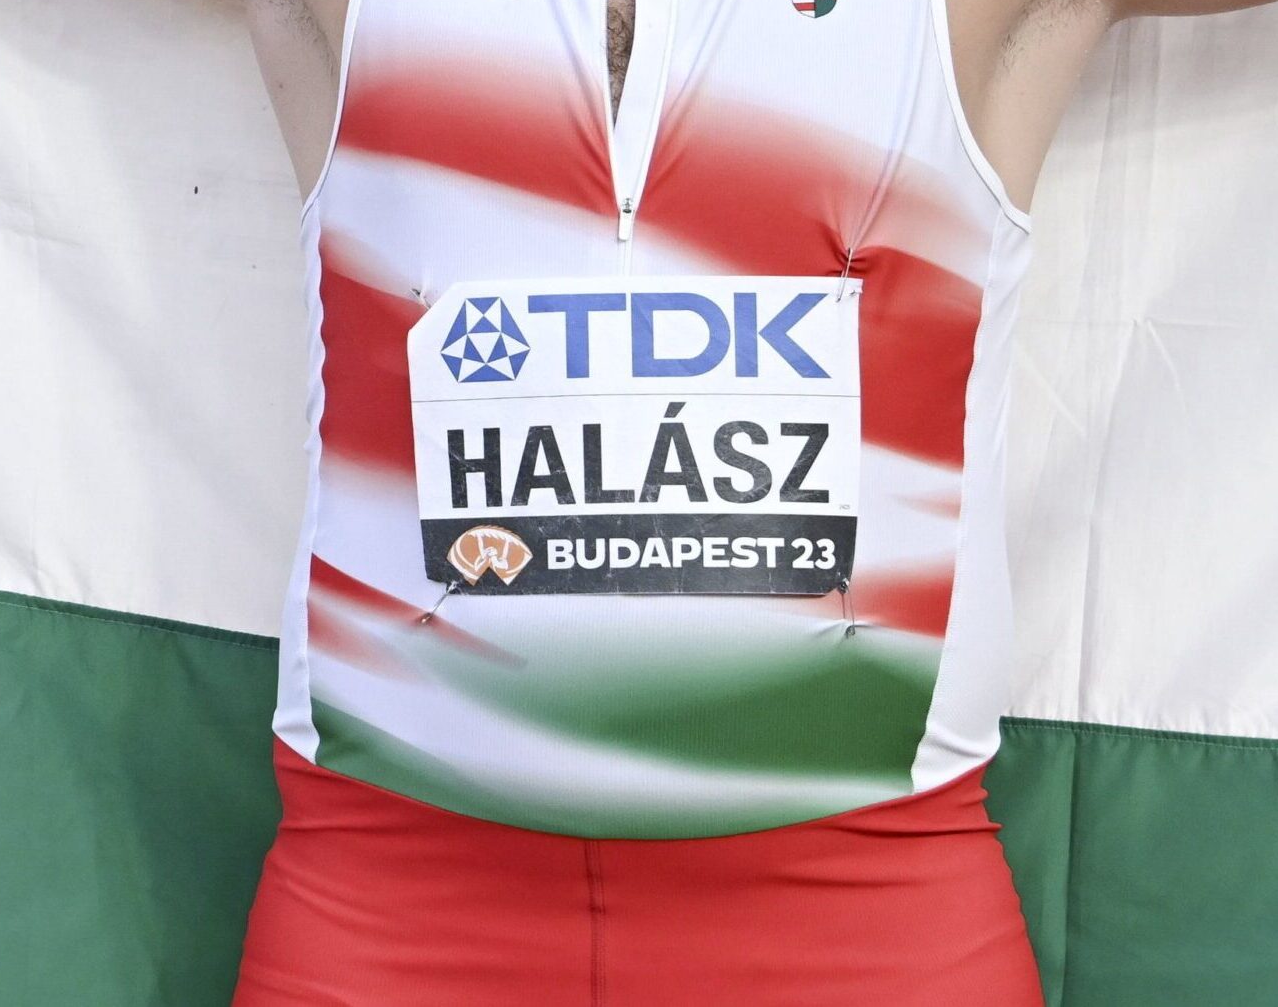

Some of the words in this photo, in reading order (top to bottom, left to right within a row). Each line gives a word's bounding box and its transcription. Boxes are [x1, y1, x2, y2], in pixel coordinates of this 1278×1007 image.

[527, 292, 832, 379] TDK
[446, 402, 830, 509] HALÁSZ
[546, 537, 786, 570] BUDAPEST
[791, 537, 836, 570] 23
